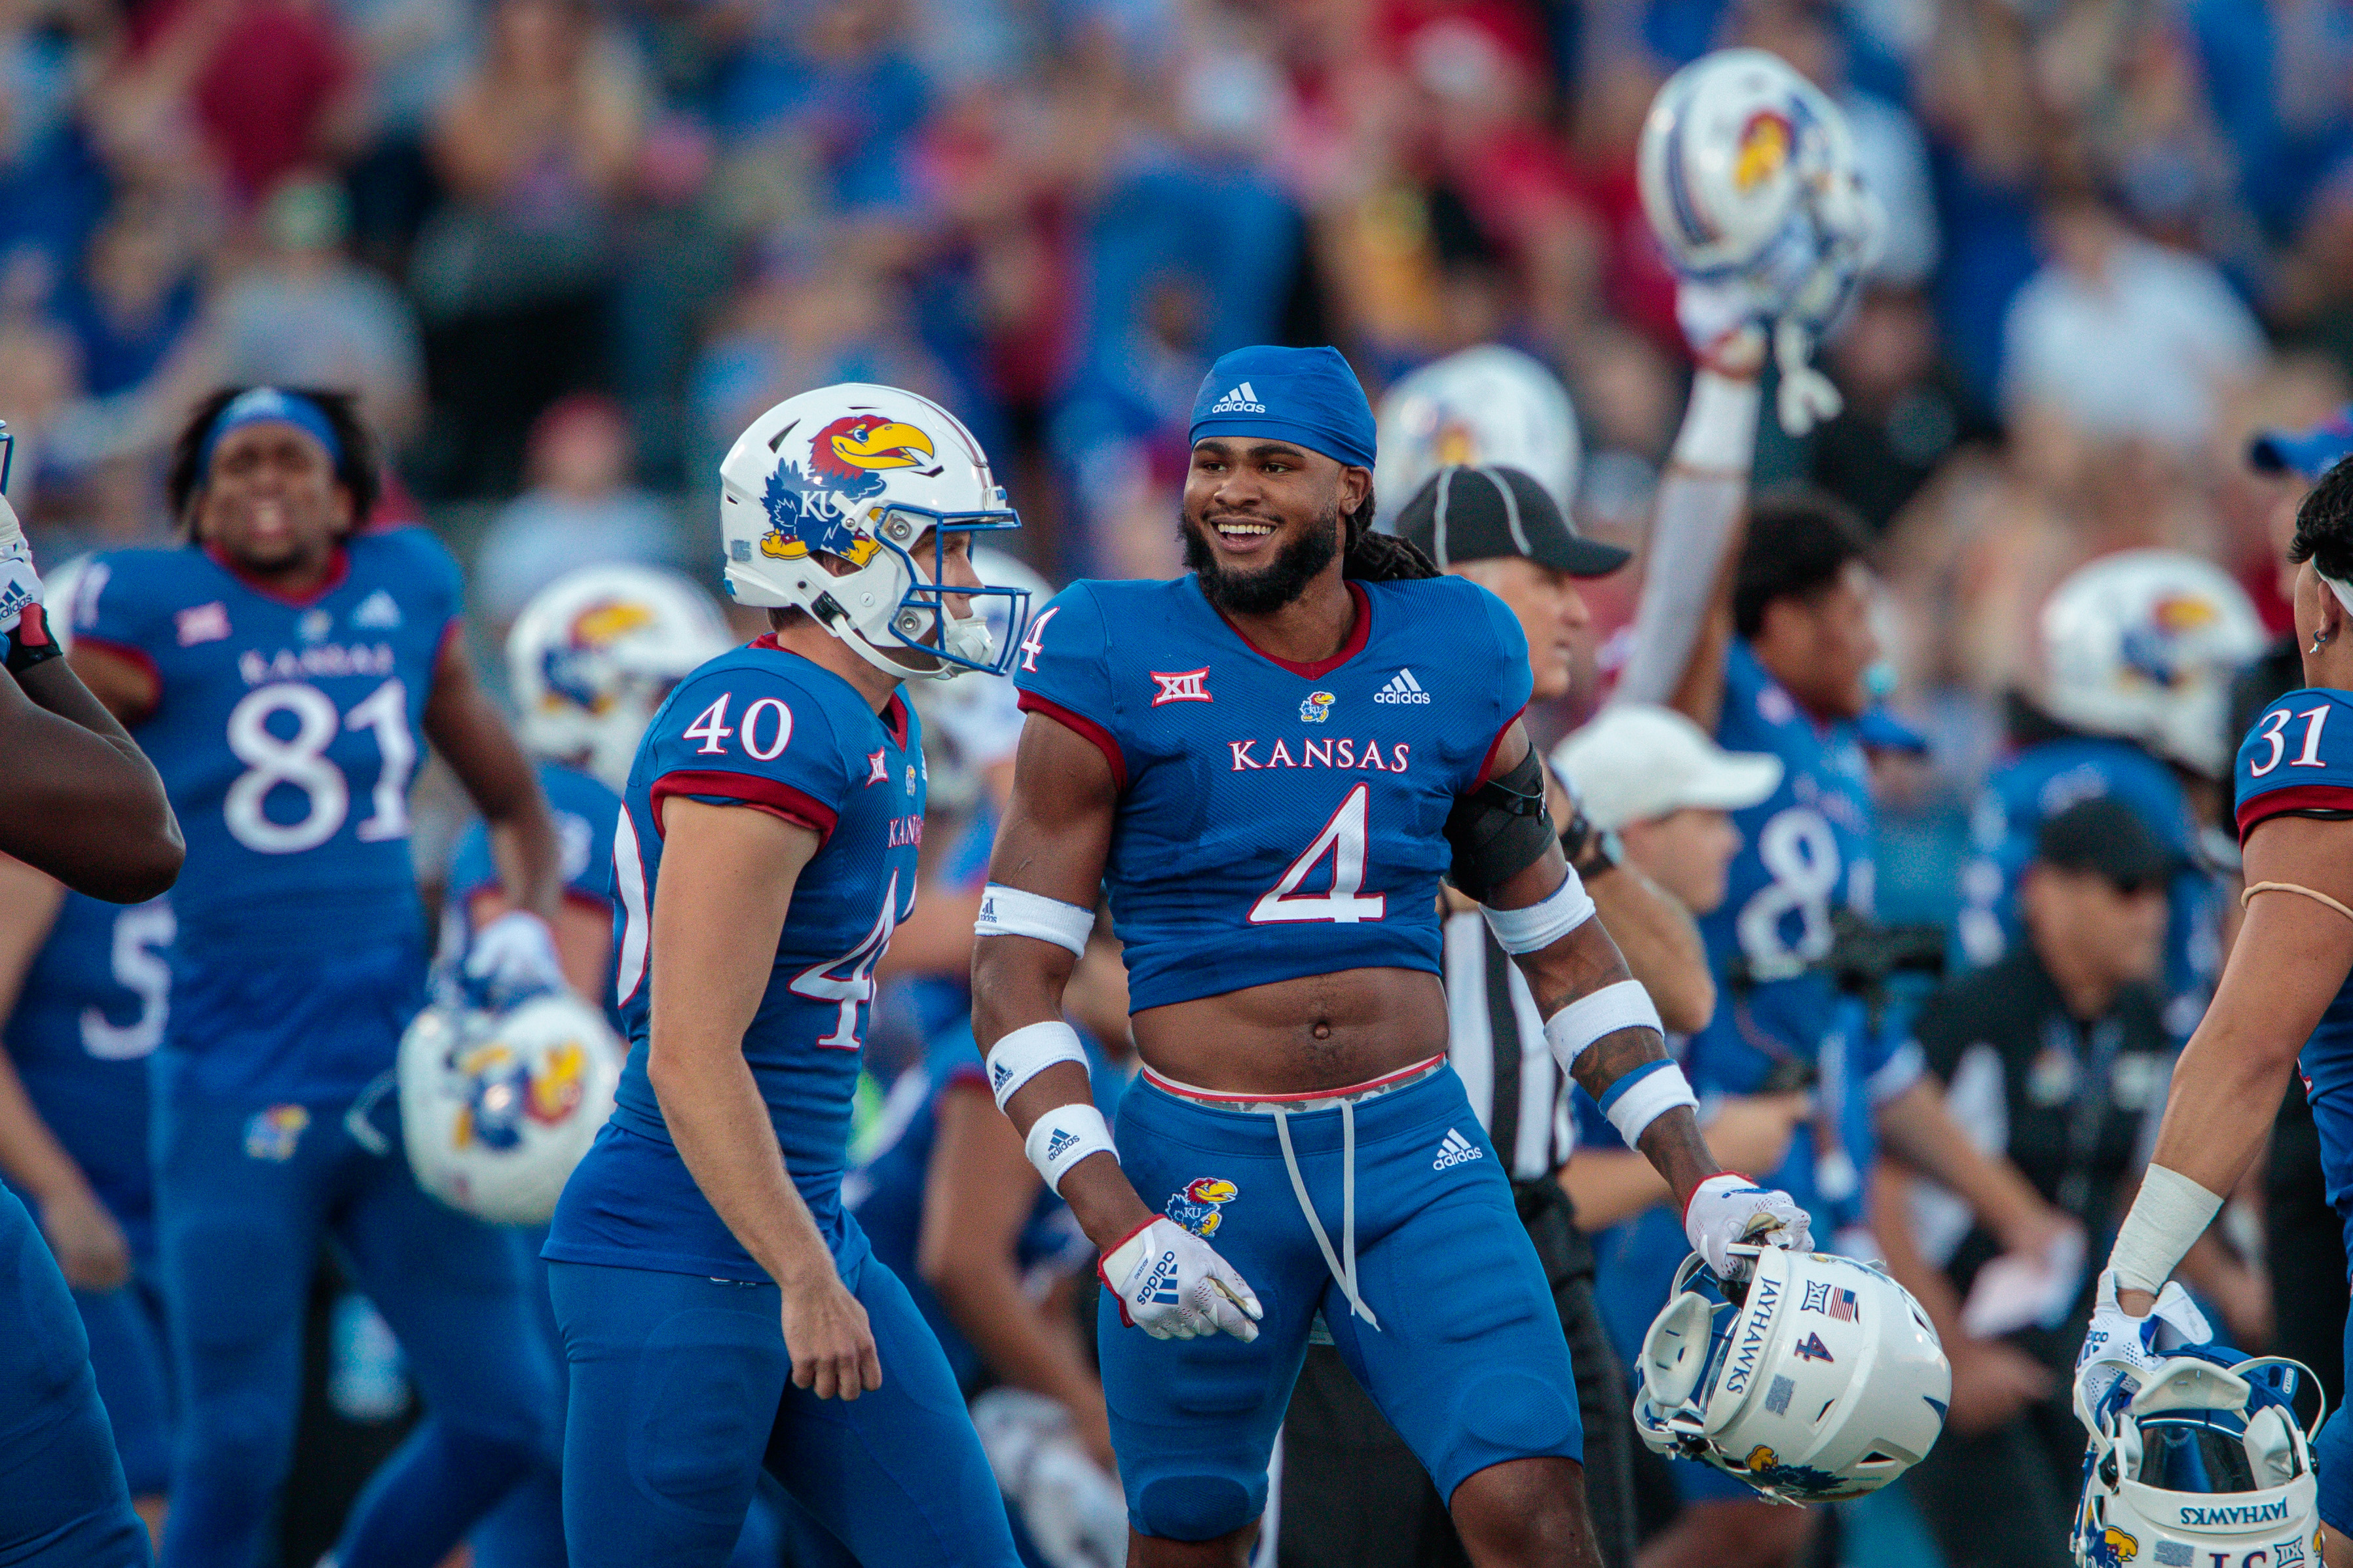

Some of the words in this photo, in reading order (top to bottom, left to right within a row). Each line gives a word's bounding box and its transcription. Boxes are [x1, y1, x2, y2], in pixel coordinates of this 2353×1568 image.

[1212, 399, 1266, 414] adidas
[799, 490, 844, 522] KU
[1020, 606, 1060, 674] 4
[1151, 668, 1212, 706] XII
[1374, 690, 1431, 704] adidas
[682, 691, 794, 762] 40
[2250, 704, 2331, 778] 31
[224, 679, 417, 854] 81
[1228, 738, 1411, 774] KANSAS
[1246, 782, 1386, 925] 4
[1736, 806, 1876, 981] 8
[787, 866, 917, 1052] 4
[1048, 1135, 1080, 1161] adidas
[1433, 1146, 1483, 1171] adidas
[1184, 1207, 1202, 1220] KU
[1137, 1250, 1175, 1305] adidas
[1726, 1275, 1782, 1395] JAYHAWKS
[1794, 1331, 1834, 1363] 4
[2181, 1496, 2289, 1525] JAYHAWKS
